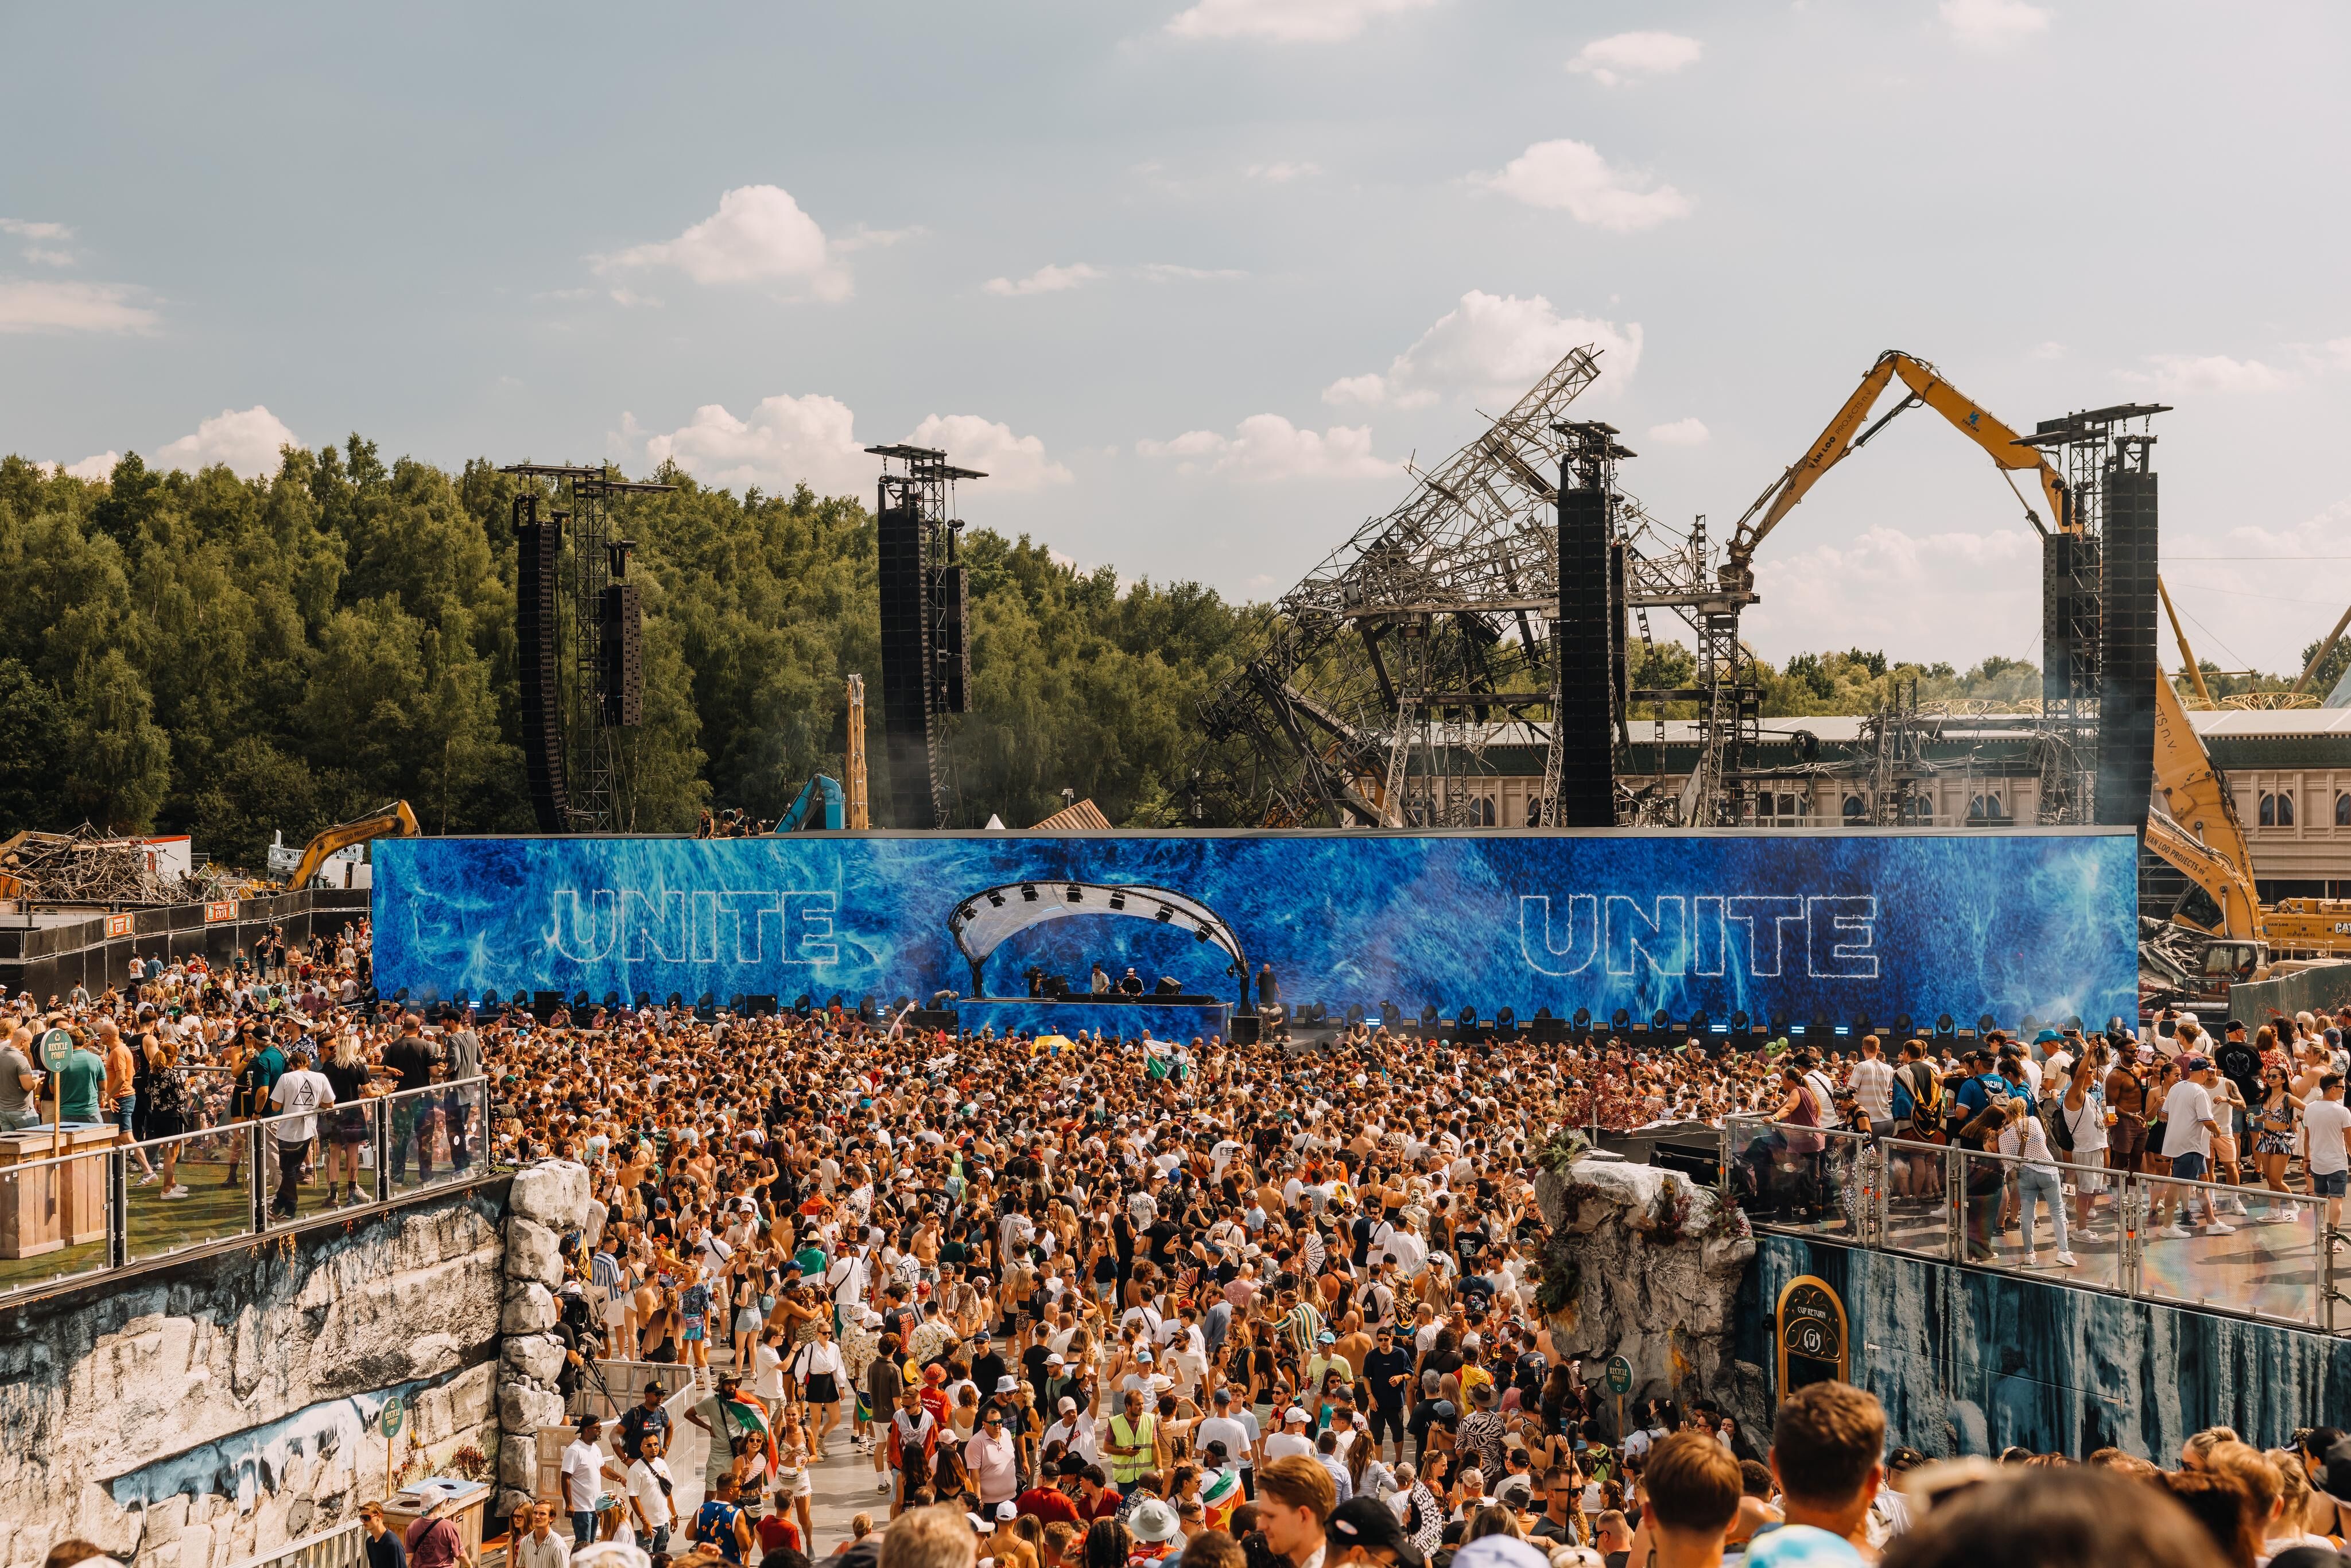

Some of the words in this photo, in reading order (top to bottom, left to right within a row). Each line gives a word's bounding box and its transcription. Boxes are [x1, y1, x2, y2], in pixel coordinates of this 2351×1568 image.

[1962, 418, 1971, 426] VAN
[1808, 452, 1824, 468] VAN
[1822, 436, 1836, 452] LOO
[1835, 401, 1863, 435] PROJECTS
[2160, 728, 2177, 754] n.v.
[354, 826, 377, 837] PROJECTS
[2146, 834, 2159, 847] VAN
[2158, 841, 2170, 853] LOO
[2170, 849, 2199, 871] PROJECTS
[215, 909, 227, 918] EXIT
[115, 923, 125, 933] EXIT
[553, 889, 839, 964] UNITE
[1519, 894, 1879, 978] UNITE
[48, 1042, 68, 1052] RECYCLE
[51, 1051, 66, 1060] POINT
[1797, 1306, 1807, 1314] CUP
[1807, 1308, 1826, 1319] RETURN
[1609, 1367, 1628, 1376] RECYCLE
[1612, 1375, 1625, 1383] POINT
[385, 1408, 401, 1420] RECYCLE
[387, 1417, 398, 1427] POINT
